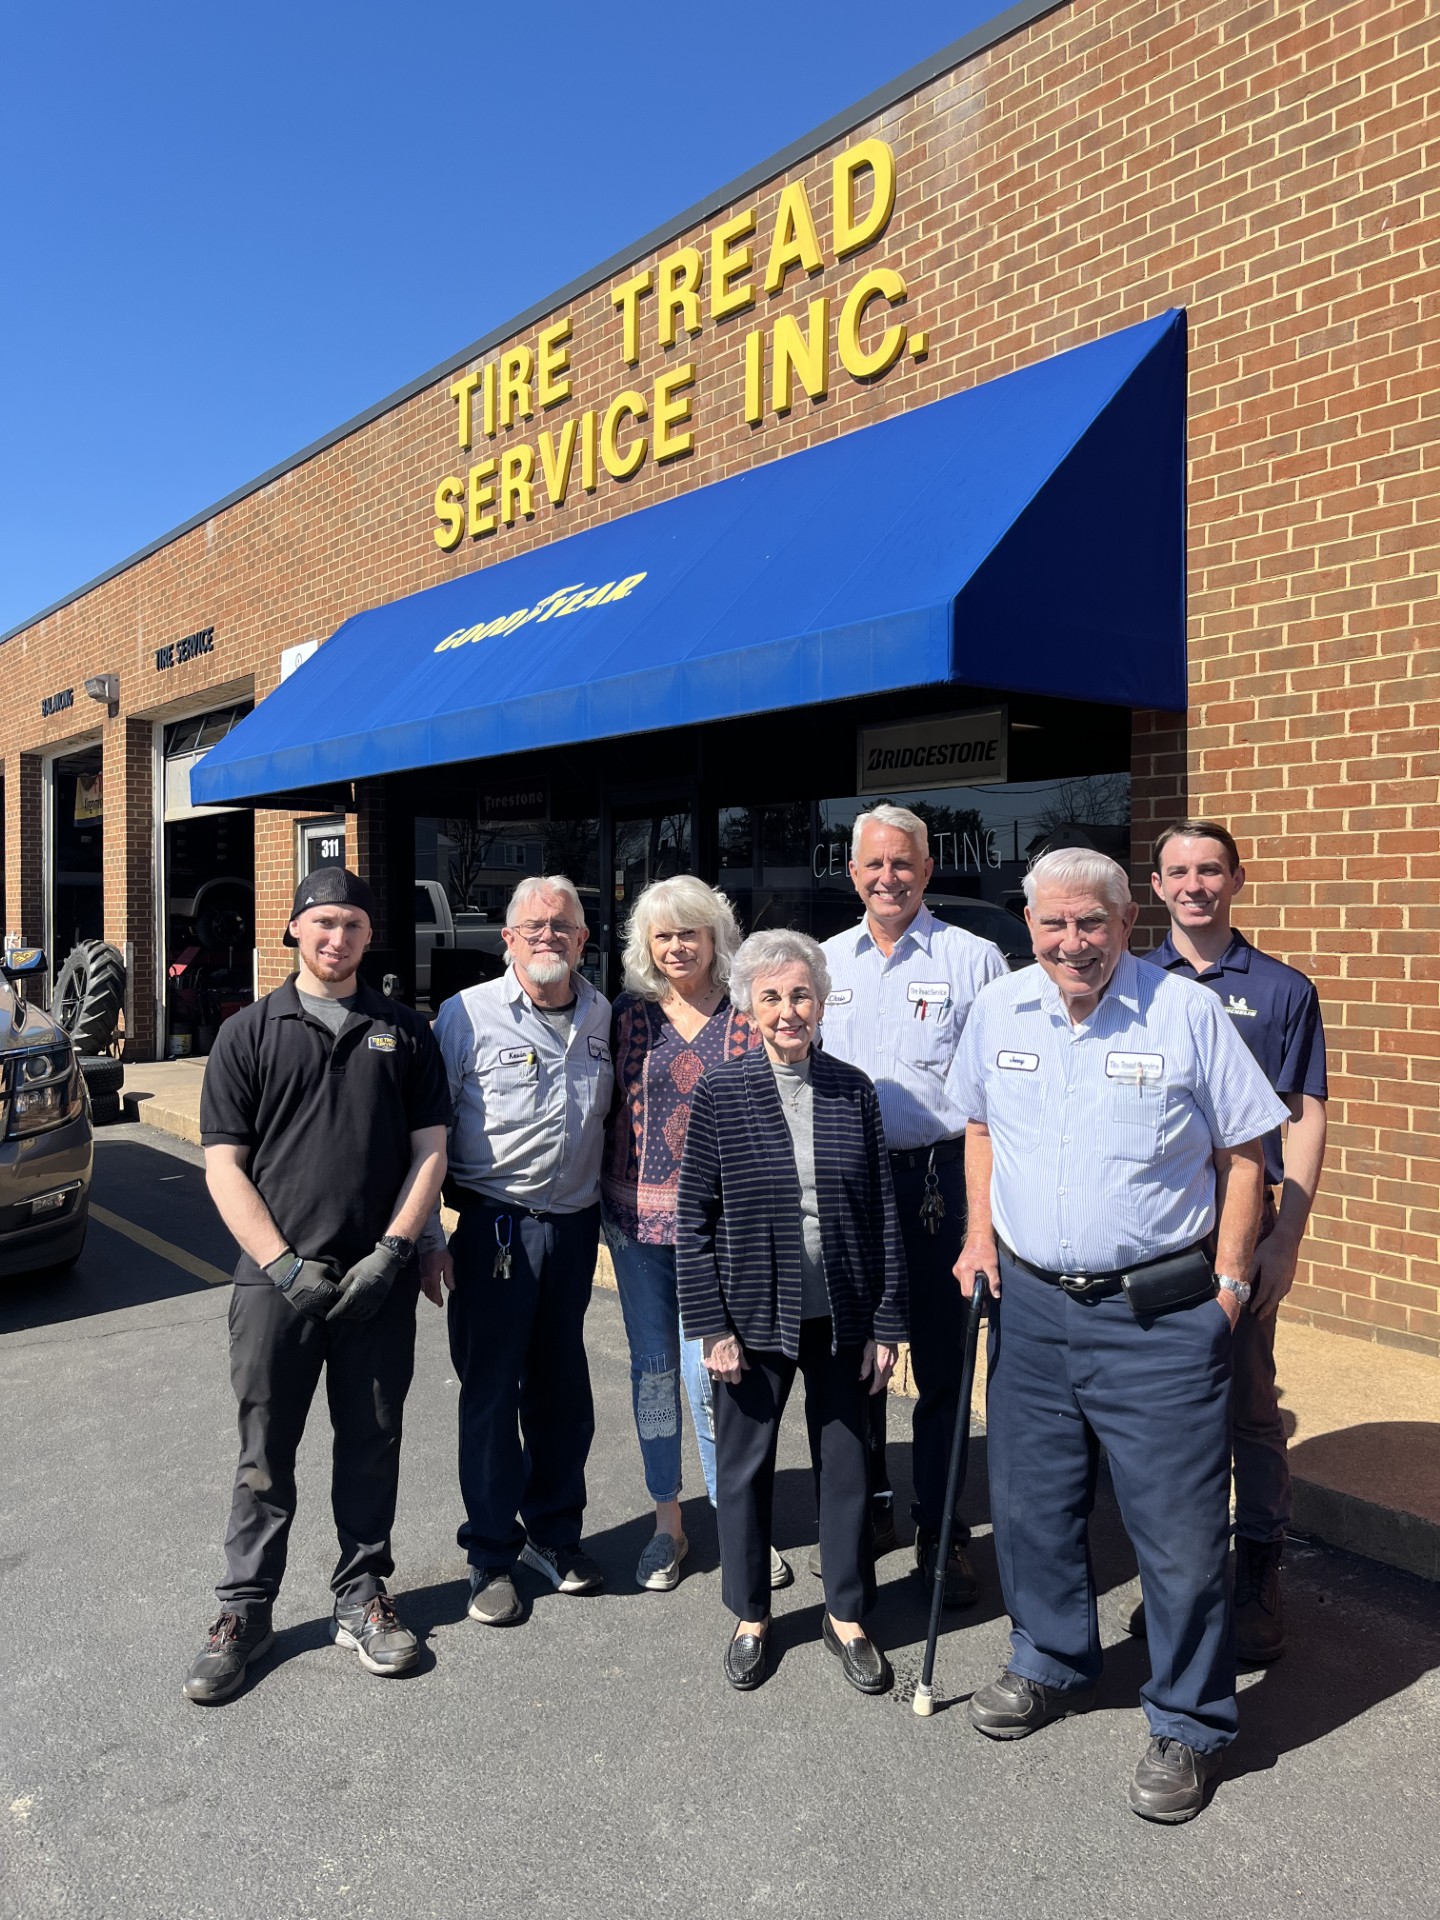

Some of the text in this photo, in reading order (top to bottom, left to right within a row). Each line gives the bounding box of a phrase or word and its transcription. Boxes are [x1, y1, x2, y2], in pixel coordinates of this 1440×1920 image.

[450, 138, 896, 449] TIRE TREAD
[434, 268, 929, 549] SERVICE INC.
[433, 571, 648, 653] GOODYEAR
[155, 626, 215, 671] TIRE SERVICE
[41, 687, 74, 718] BALANCING
[866, 739, 1000, 771] BRIDGESTONE
[483, 791, 544, 812] Firestone
[321, 838, 339, 858] 311
[813, 828, 1002, 878] CELTING
[508, 1051, 527, 1060] Kevin
